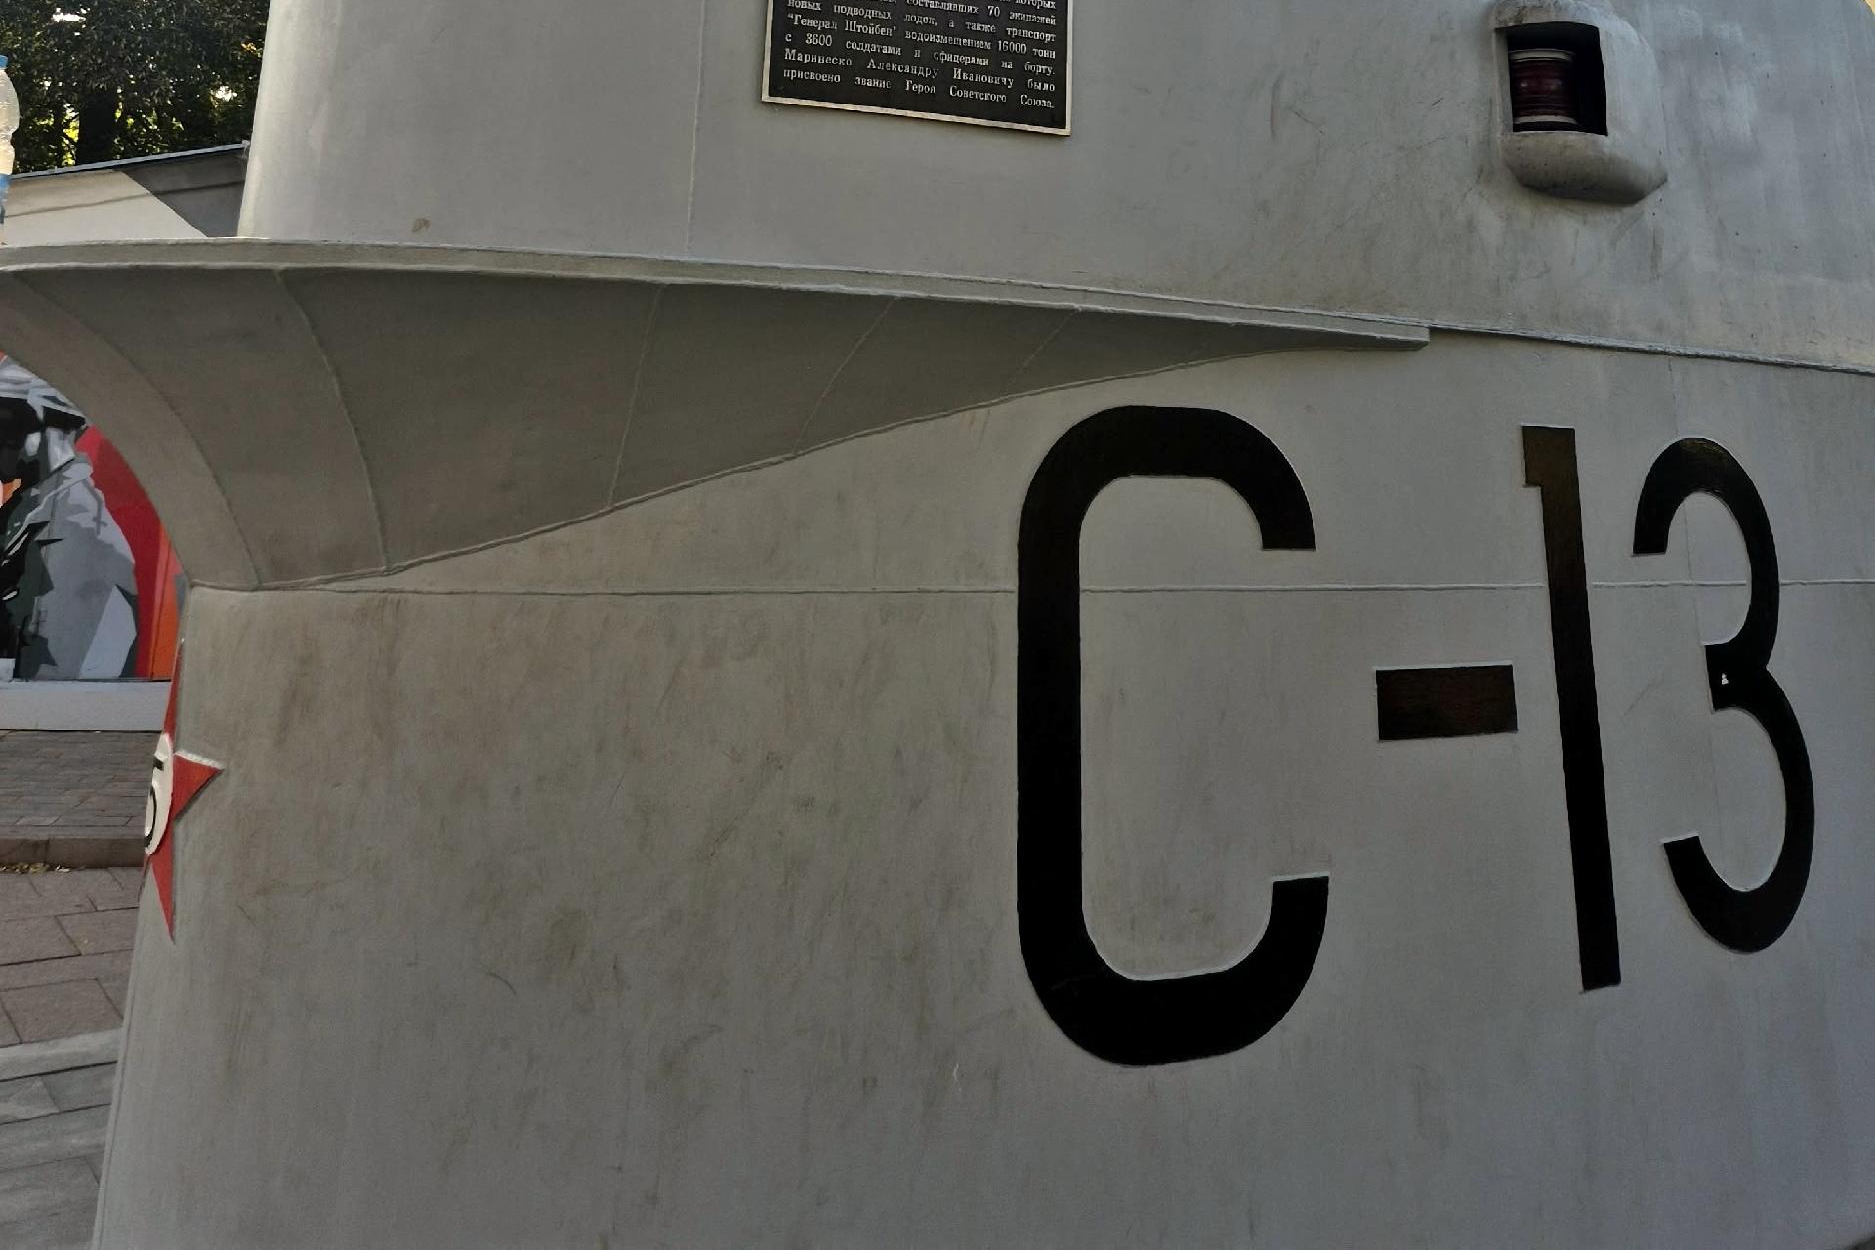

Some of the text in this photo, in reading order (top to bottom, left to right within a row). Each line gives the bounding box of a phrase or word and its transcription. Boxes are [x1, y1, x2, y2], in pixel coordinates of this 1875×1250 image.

[833, 4, 892, 19] подводных
[965, 21, 996, 32] также
[1005, 27, 1056, 43] транспорт
[987, 5, 1001, 16] 70
[1009, 11, 1056, 25] экипажей
[805, 32, 833, 46] 3600
[845, 40, 901, 55] солдатами
[997, 39, 1027, 53] 16000
[1032, 48, 1056, 58] тонн
[783, 69, 841, 82] присвоено
[854, 77, 891, 88] звание
[905, 79, 936, 93] Героя
[949, 85, 1007, 102] Советского
[784, 47, 1056, 91] Маринеско Александру Ивановичу было
[1017, 405, 1814, 1066] С-13
